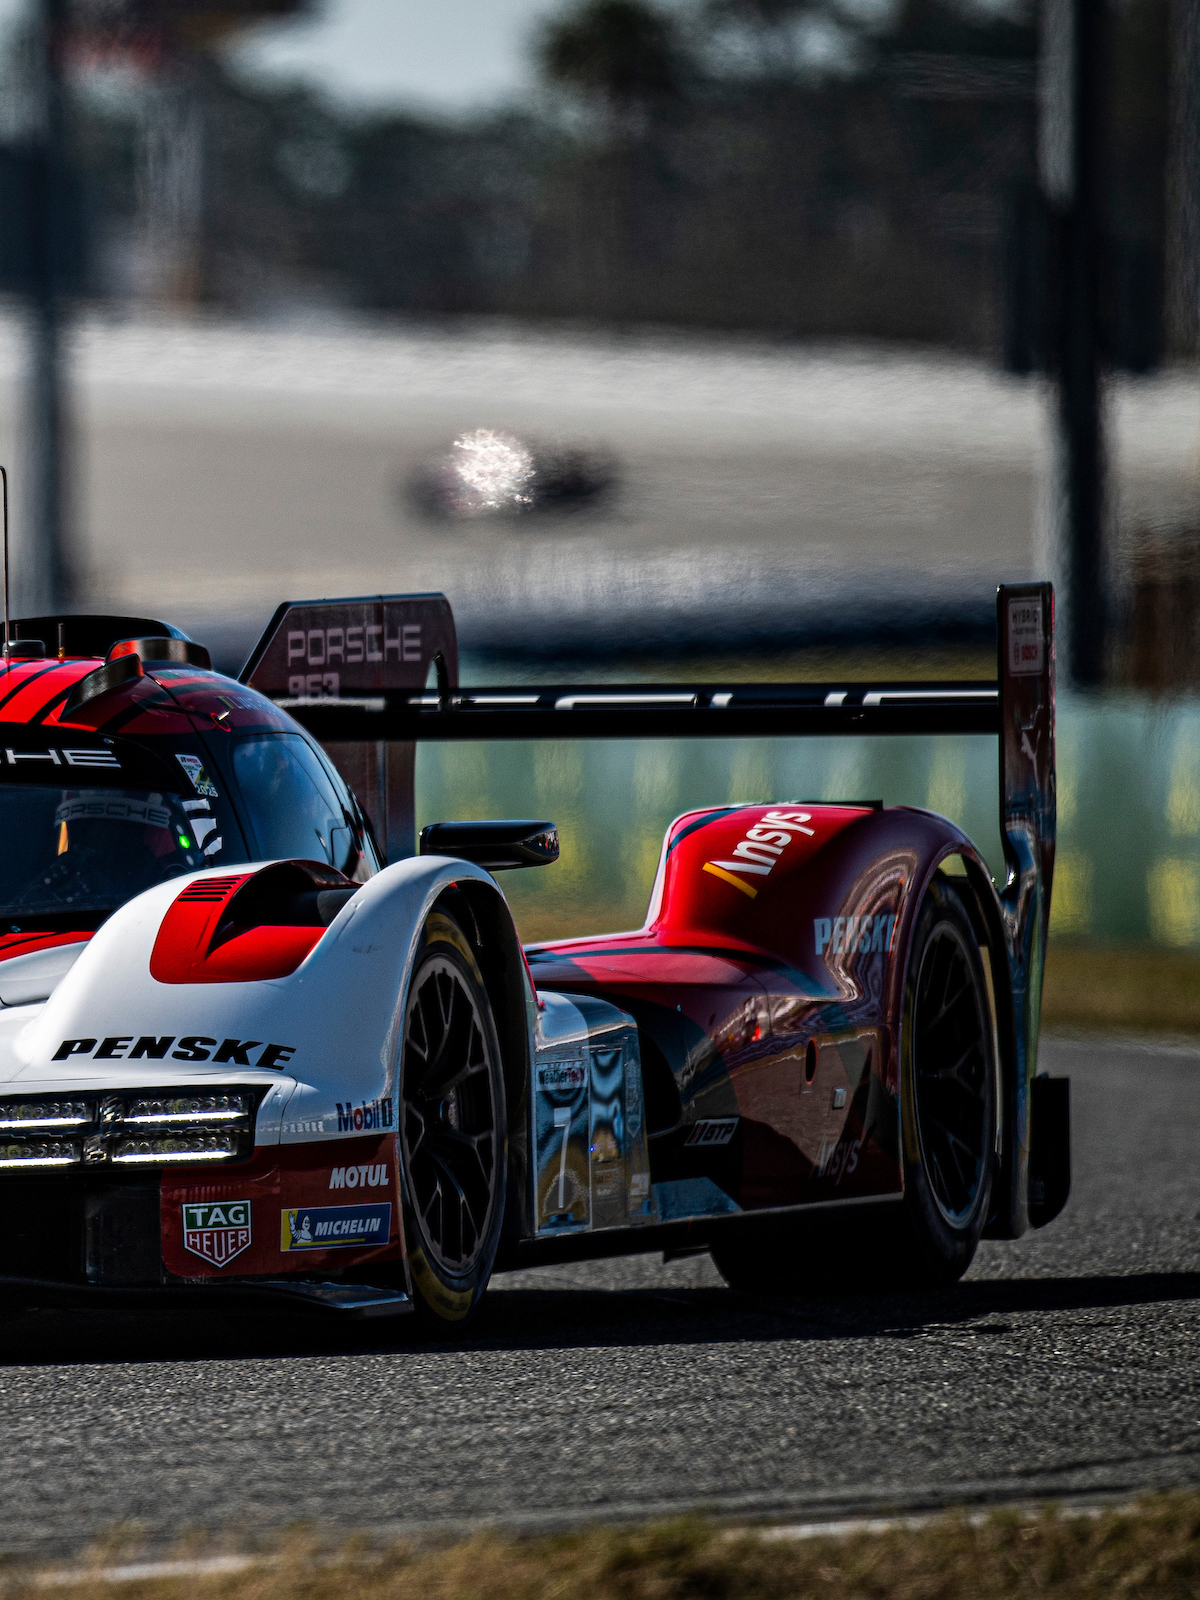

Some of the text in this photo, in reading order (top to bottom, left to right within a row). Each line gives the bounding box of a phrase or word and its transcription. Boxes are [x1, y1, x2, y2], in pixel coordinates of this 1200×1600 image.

[287, 624, 422, 667] PORSCHE
[288, 673, 340, 699] 963
[194, 784, 219, 798] 2025
[702, 811, 815, 900] Ansys
[51, 1036, 296, 1071] PENSKE
[539, 1067, 585, 1085] WeatherTech
[336, 1100, 380, 1132] Mobil
[703, 1123, 736, 1141] GTP
[329, 1164, 389, 1189] MOTUL
[189, 1206, 245, 1227] TAG
[315, 1218, 381, 1236] MICHELIN
[189, 1230, 247, 1261] HEUER
